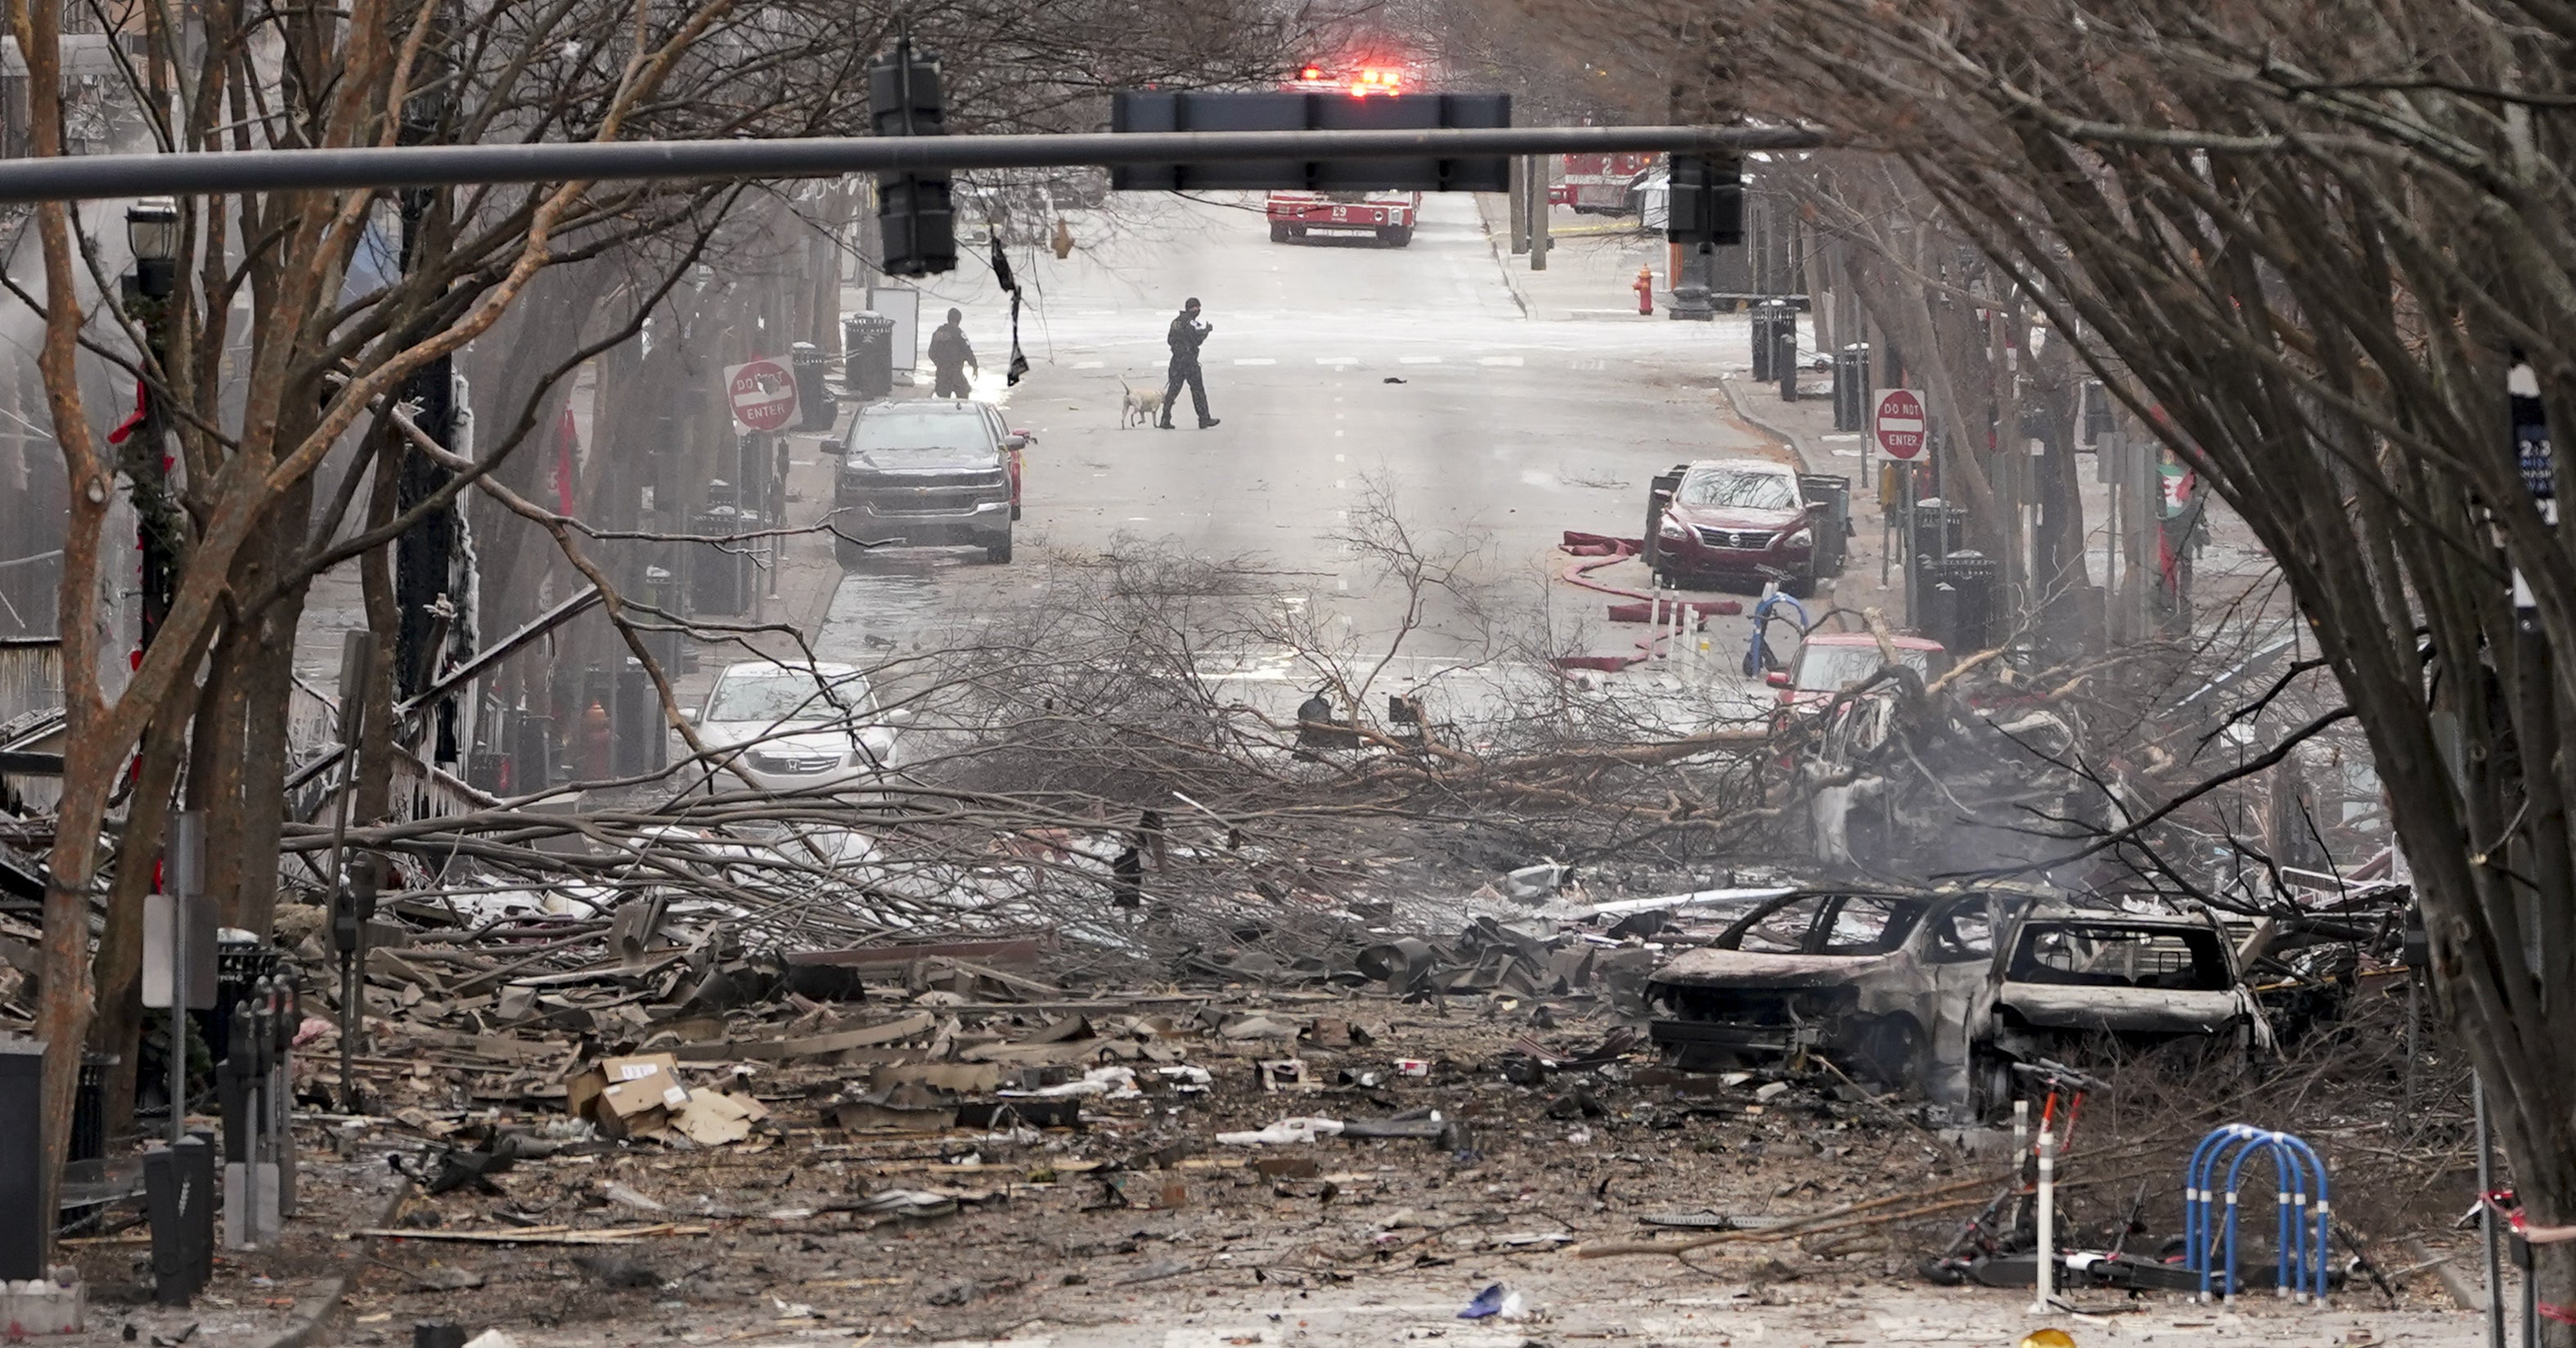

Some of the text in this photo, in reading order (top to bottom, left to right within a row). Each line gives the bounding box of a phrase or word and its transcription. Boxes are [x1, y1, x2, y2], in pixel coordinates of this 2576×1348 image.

[1333, 206, 1346, 217] E9
[737, 378, 753, 391] DO
[746, 403, 785, 420] ENTER
[1884, 403, 1918, 416] DO NOT
[1889, 434, 1917, 446] ENTER
